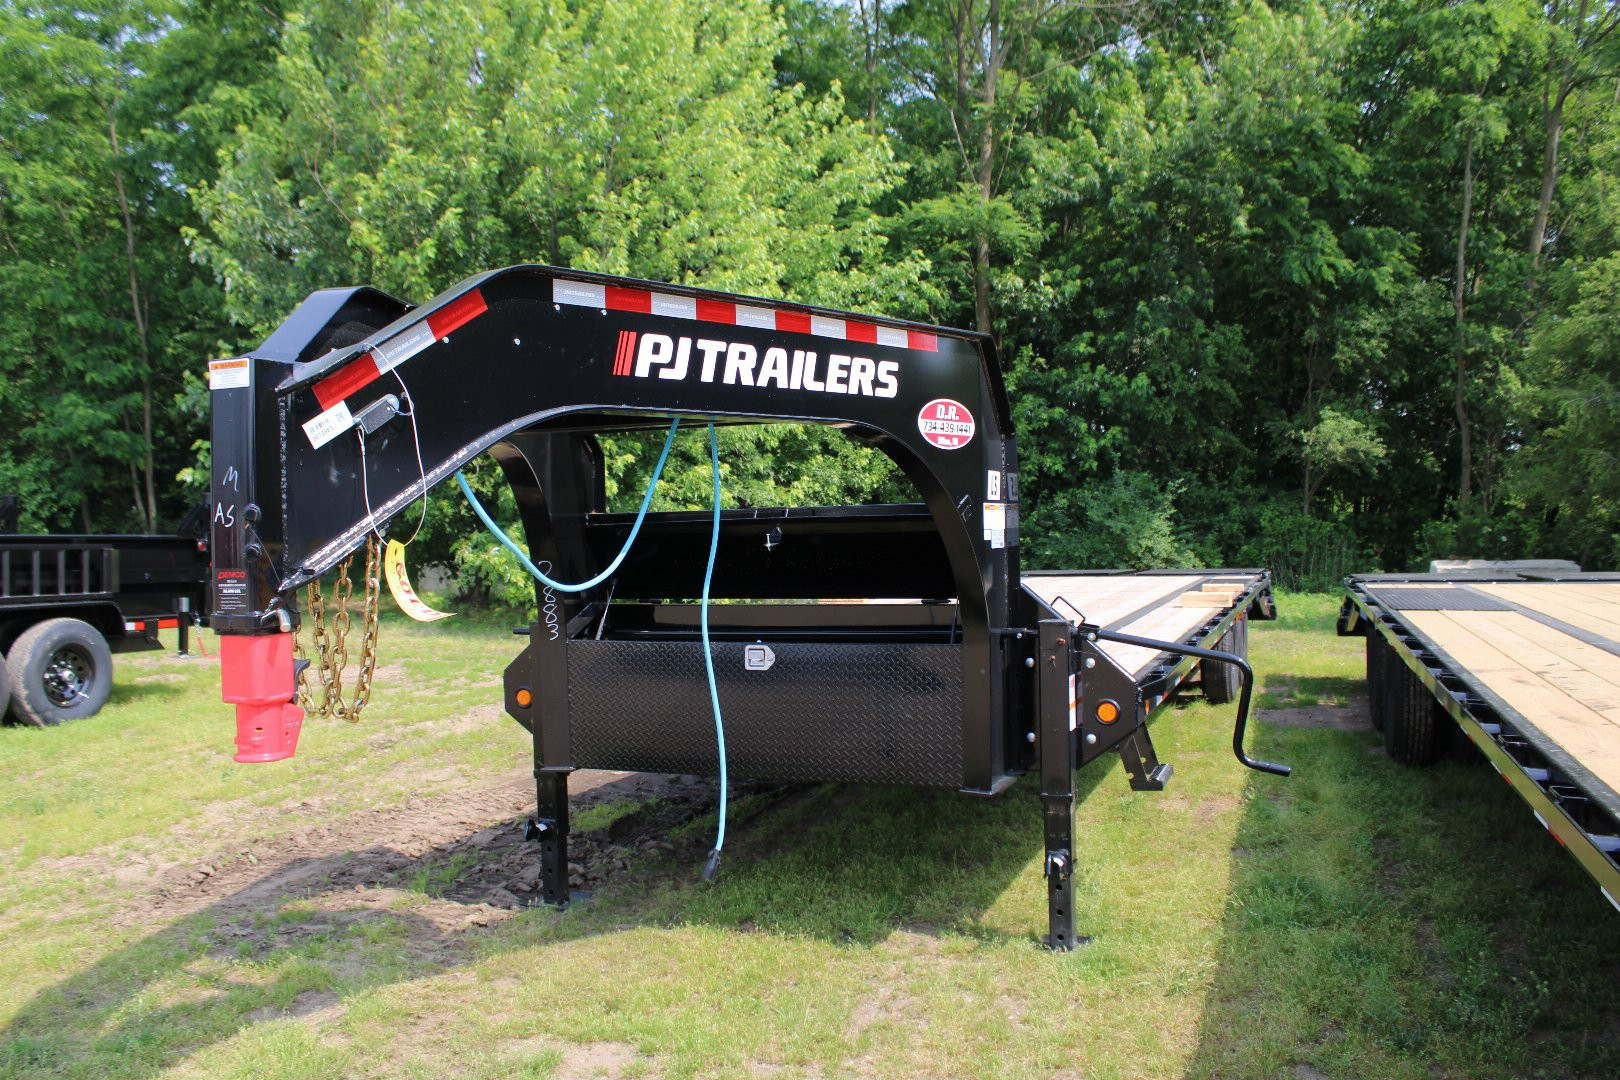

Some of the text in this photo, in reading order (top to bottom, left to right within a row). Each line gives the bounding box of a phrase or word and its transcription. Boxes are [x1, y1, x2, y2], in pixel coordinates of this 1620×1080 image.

[635, 333, 899, 399] PJ TRAILERS
[936, 404, 960, 420] D.R.
[222, 466, 239, 492] M
[214, 502, 235, 528] AS
[218, 571, 246, 579] DEMCO
